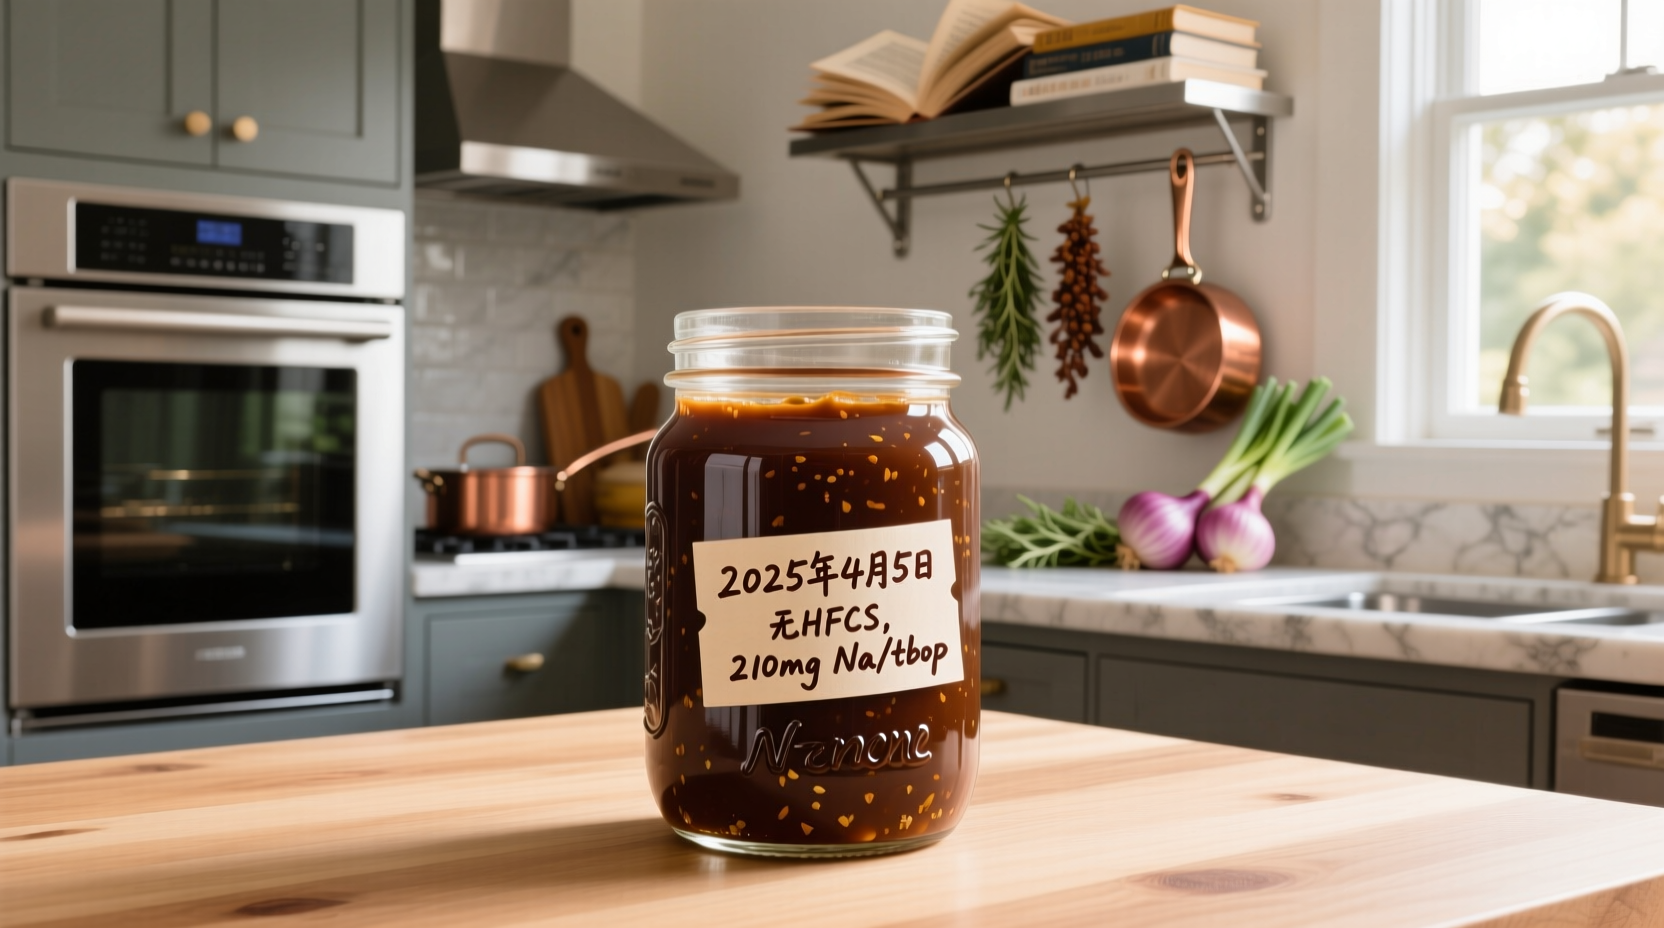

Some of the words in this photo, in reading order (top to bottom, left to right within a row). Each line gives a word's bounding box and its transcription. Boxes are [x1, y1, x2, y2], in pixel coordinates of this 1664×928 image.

[717, 549, 933, 599] 2025年4月5日
[769, 603, 890, 640] 无HFCS,
[729, 654, 821, 691] 210mg
[833, 634, 948, 676] Na/tbop
